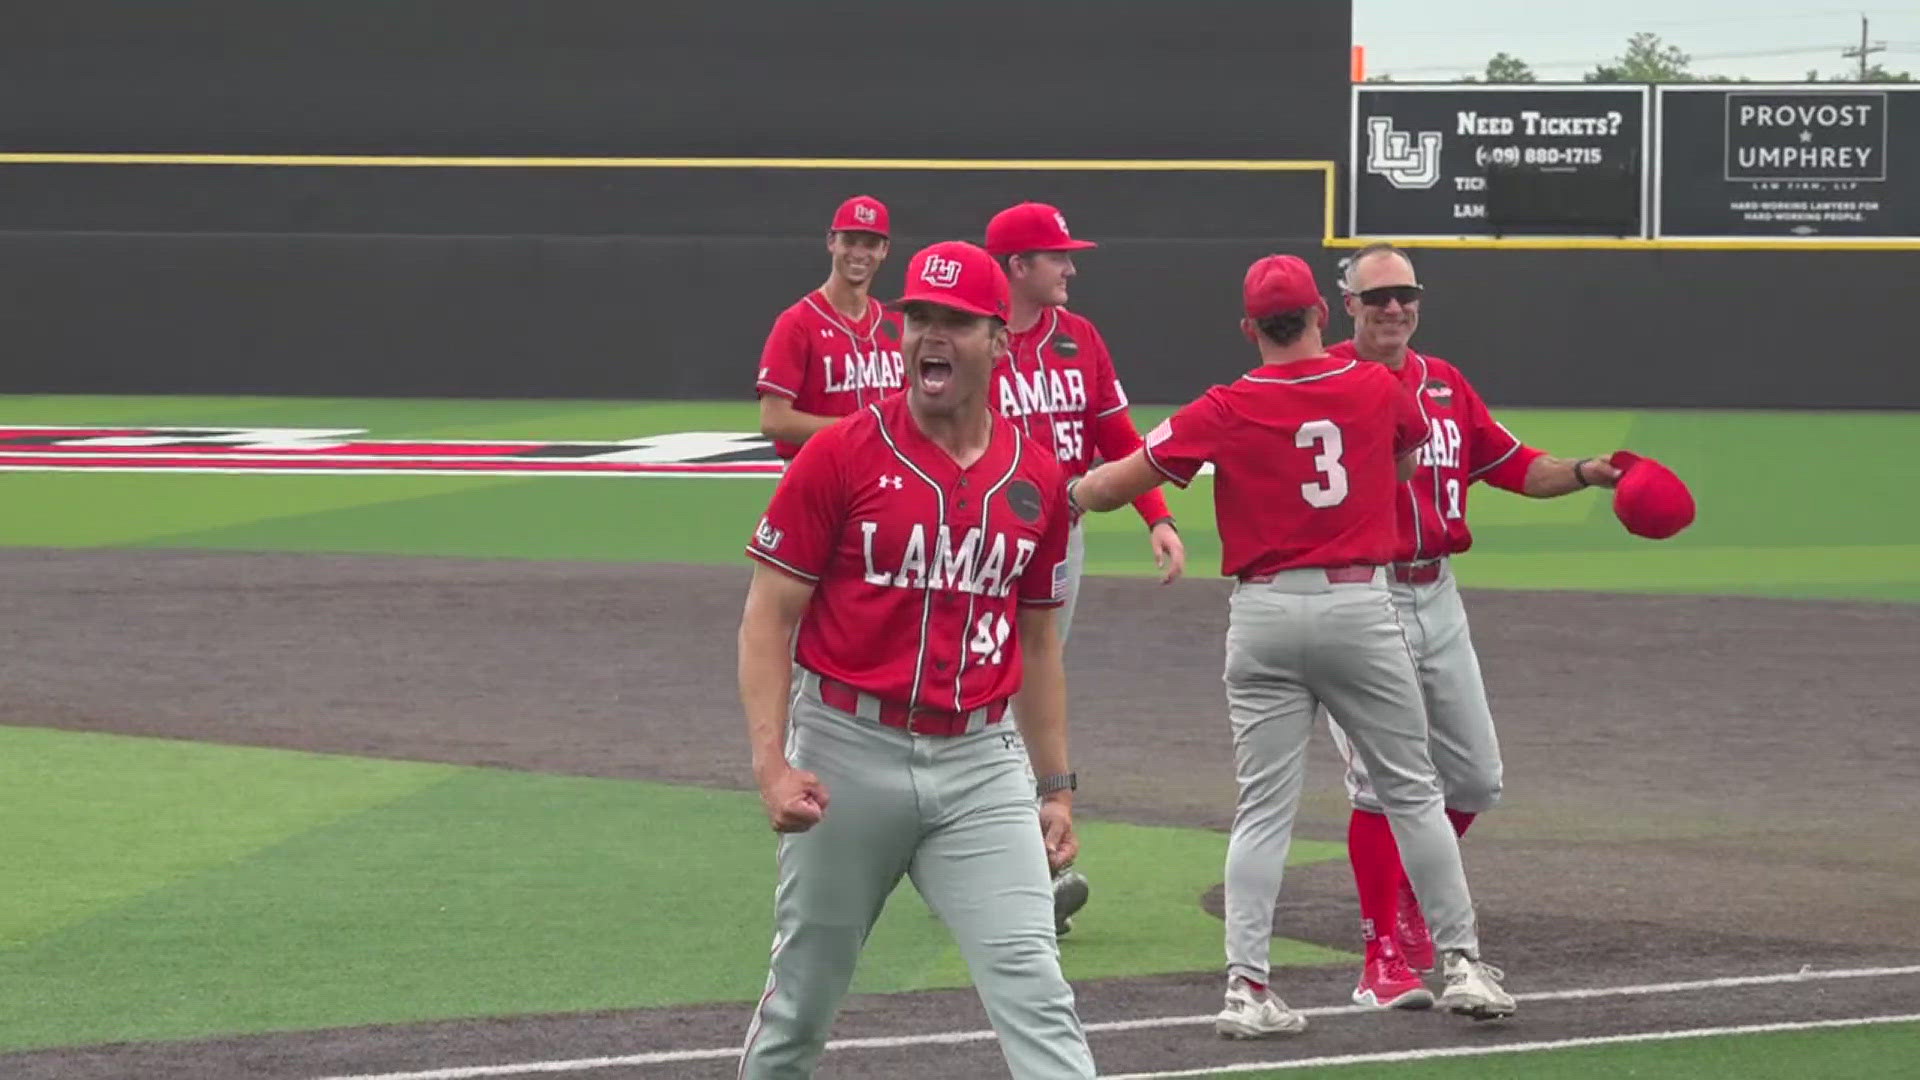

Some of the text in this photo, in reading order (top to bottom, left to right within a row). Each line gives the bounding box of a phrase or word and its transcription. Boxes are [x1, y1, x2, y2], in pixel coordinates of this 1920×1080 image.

[1457, 111, 1622, 135] NEED TICKETS?
[1740, 105, 1871, 126] PROVOST
[1367, 116, 1442, 189] LU
[1525, 147, 1602, 164] 880-1715
[1738, 147, 1871, 168] UMPHREY
[921, 254, 962, 288] LU
[999, 368, 1087, 418] AMAR
[1056, 421, 1083, 462] 55
[1295, 418, 1348, 508] 3
